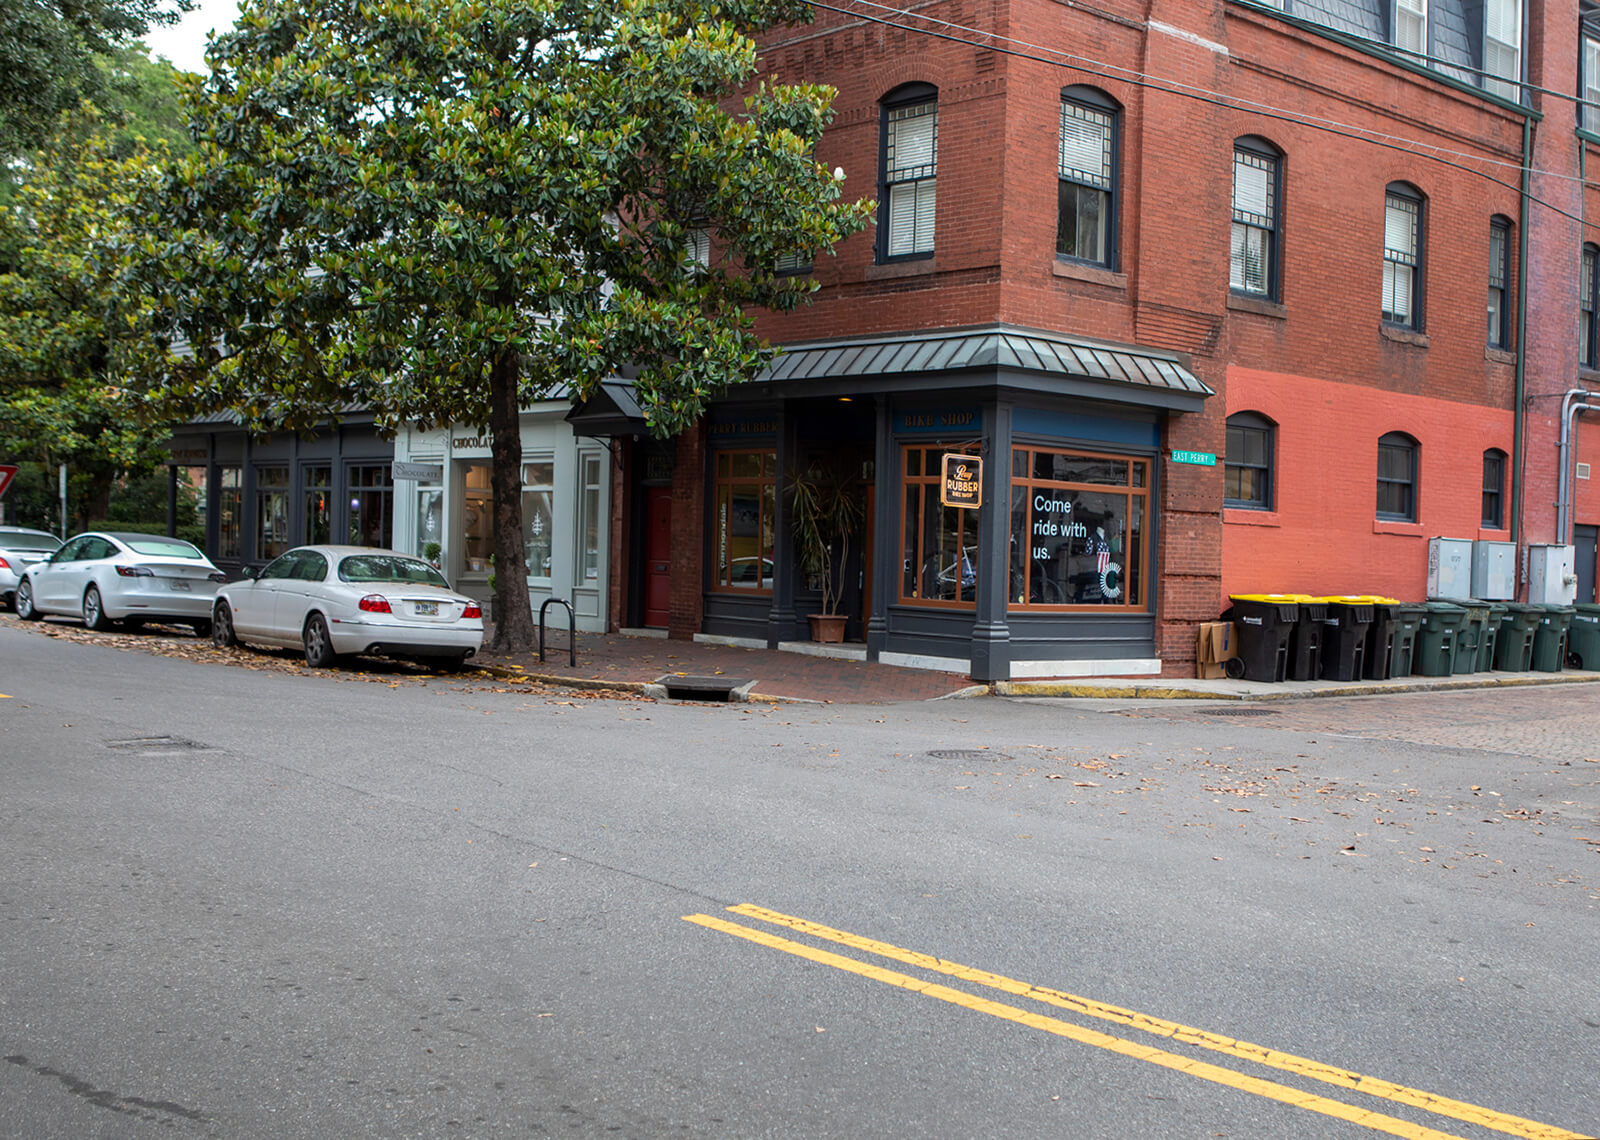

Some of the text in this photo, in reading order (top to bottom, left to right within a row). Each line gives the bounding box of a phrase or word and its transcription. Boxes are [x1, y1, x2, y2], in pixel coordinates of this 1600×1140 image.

[905, 412, 973, 426] BIKE SHOP
[1173, 451, 1188, 462] EAST
[1190, 453, 1208, 464] PERRY
[947, 479, 978, 492] RUBBER
[1034, 495, 1072, 513] Come
[1033, 520, 1087, 538] ride with
[1033, 547, 1051, 559] us.
